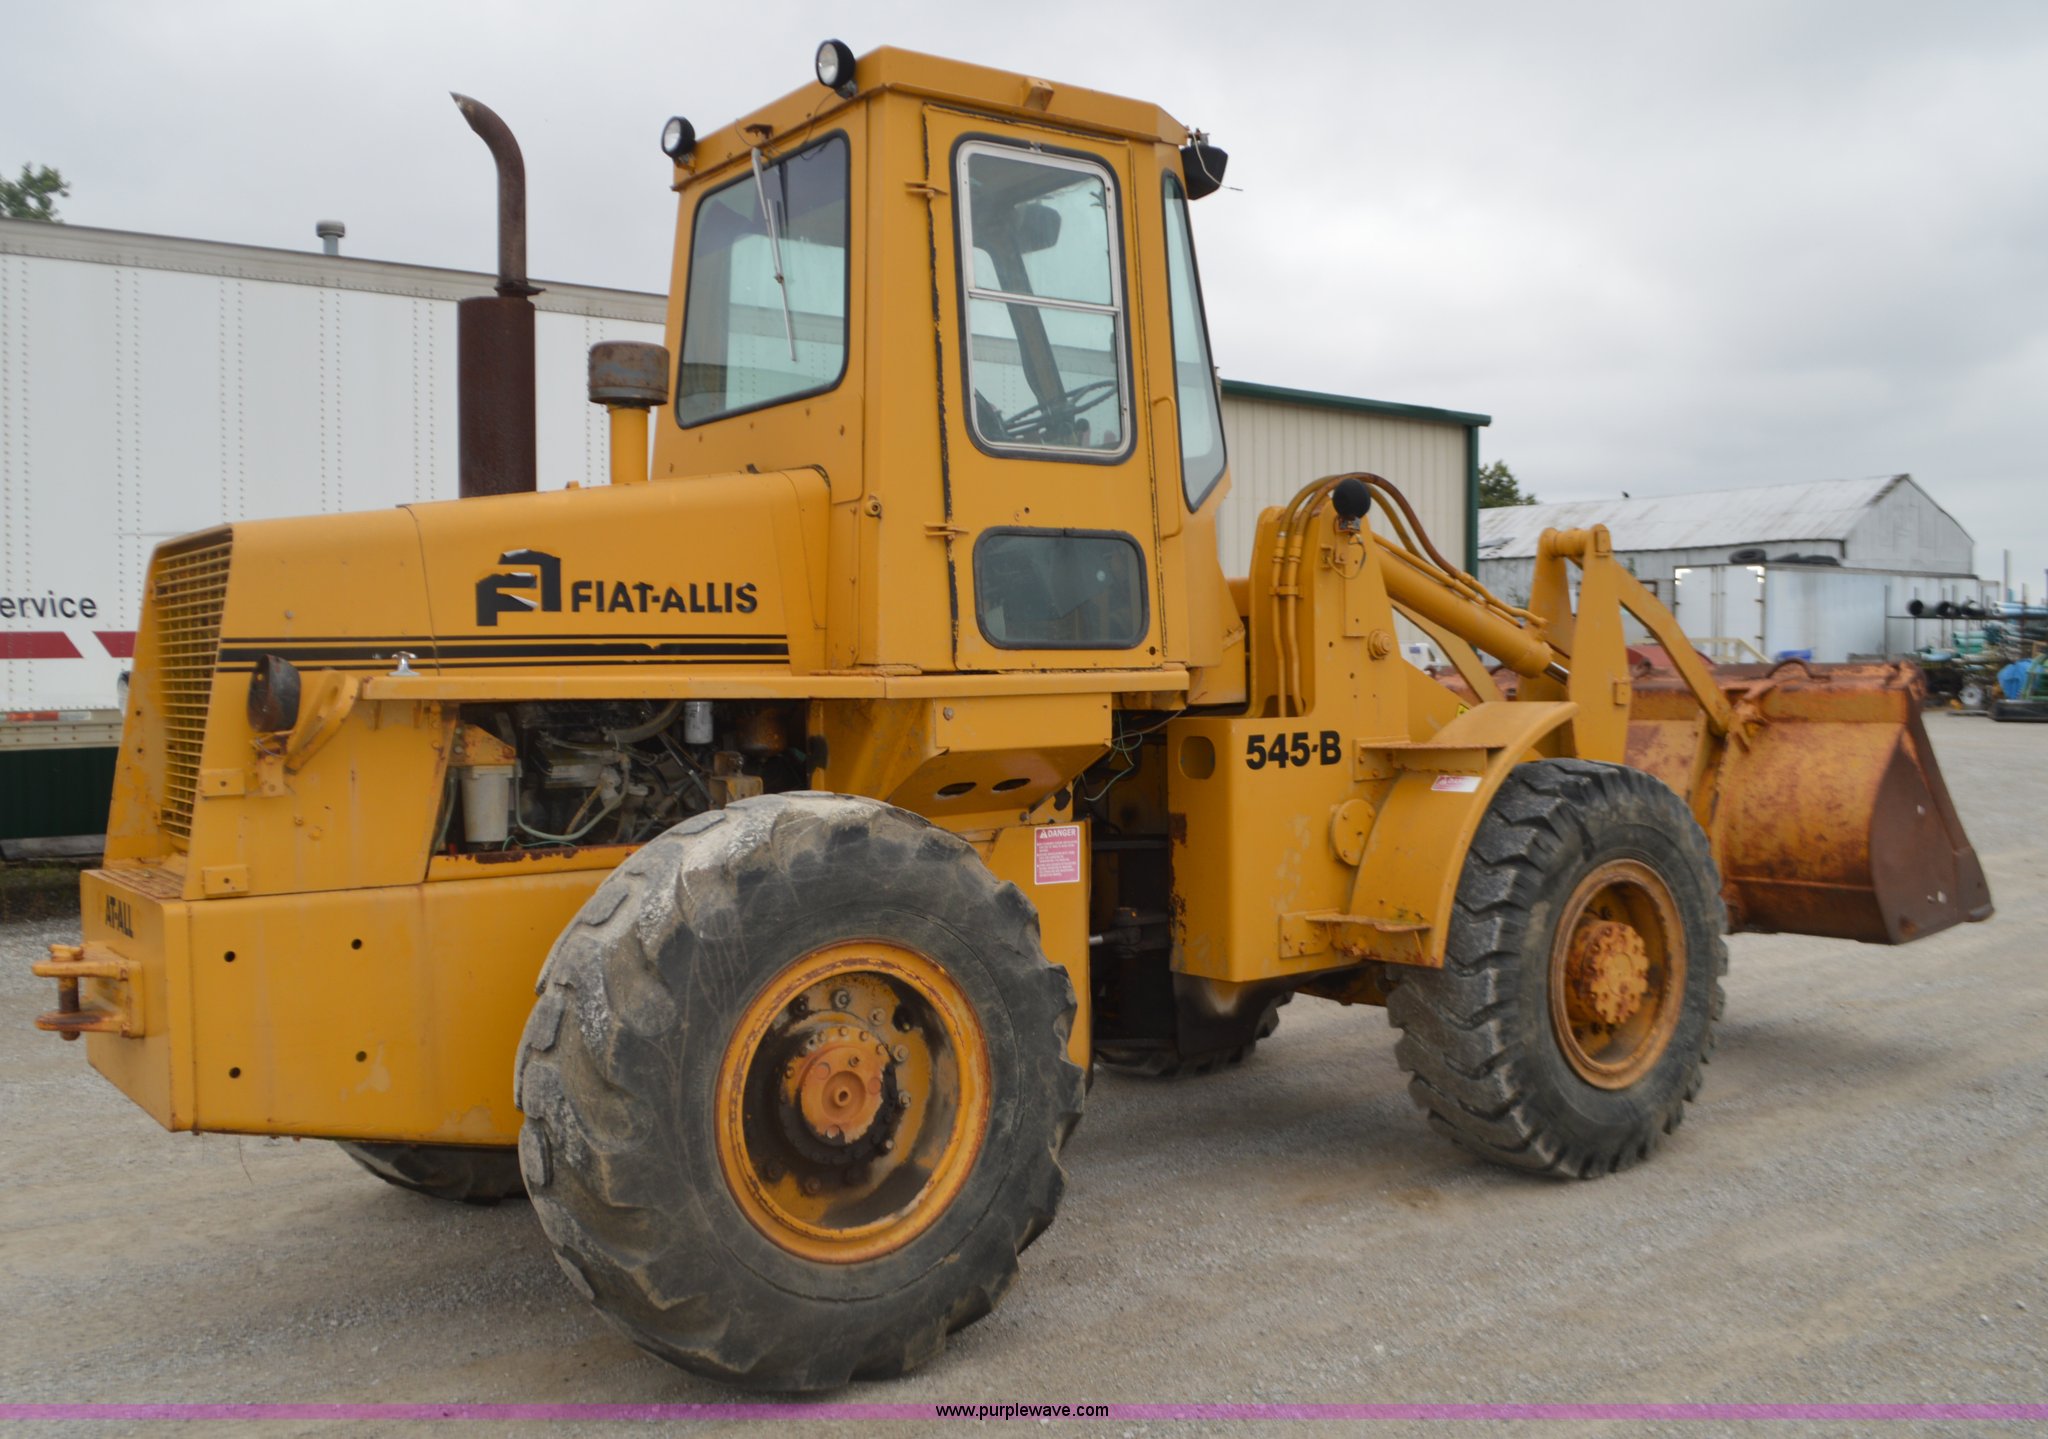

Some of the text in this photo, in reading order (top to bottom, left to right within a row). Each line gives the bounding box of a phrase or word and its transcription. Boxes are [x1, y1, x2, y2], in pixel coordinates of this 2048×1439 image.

[570, 580, 759, 614] FIAT-ALLIS
[1245, 730, 1342, 770] 545-B
[1048, 828, 1077, 838] DANGER
